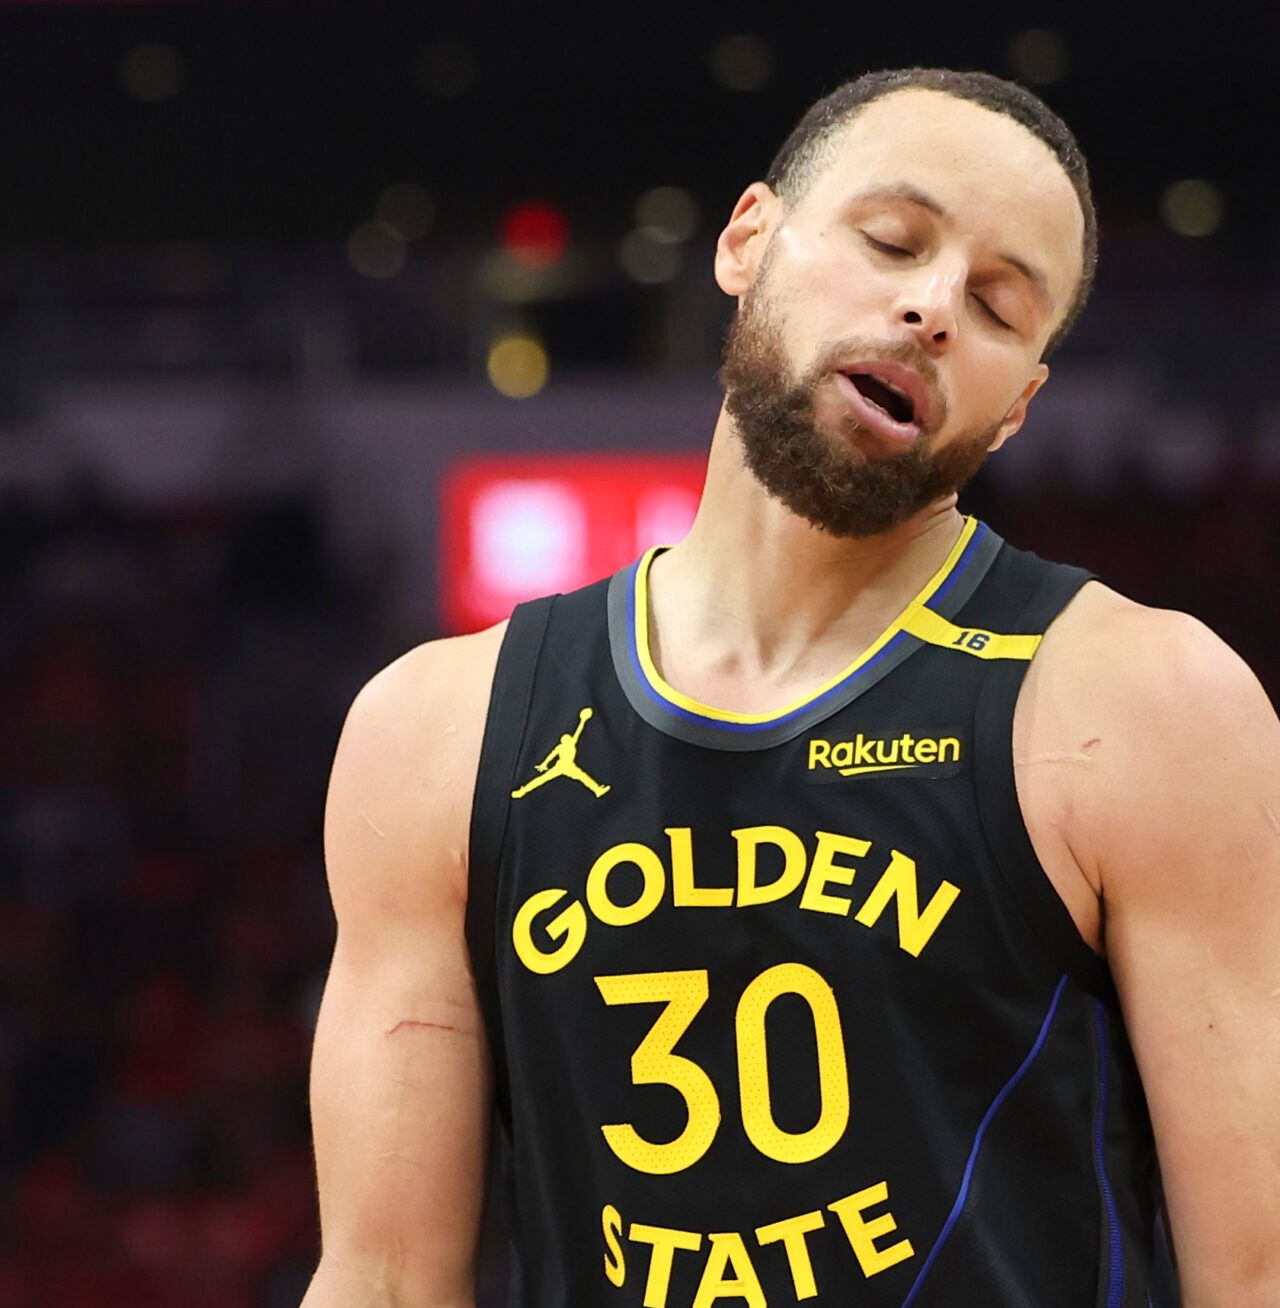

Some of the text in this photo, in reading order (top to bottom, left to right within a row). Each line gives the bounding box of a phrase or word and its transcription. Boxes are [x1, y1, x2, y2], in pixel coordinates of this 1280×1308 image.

[952, 631, 990, 651] 16
[808, 733, 961, 777] Rakuten
[512, 825, 961, 976] GOLDEN
[593, 962, 850, 1175] 30
